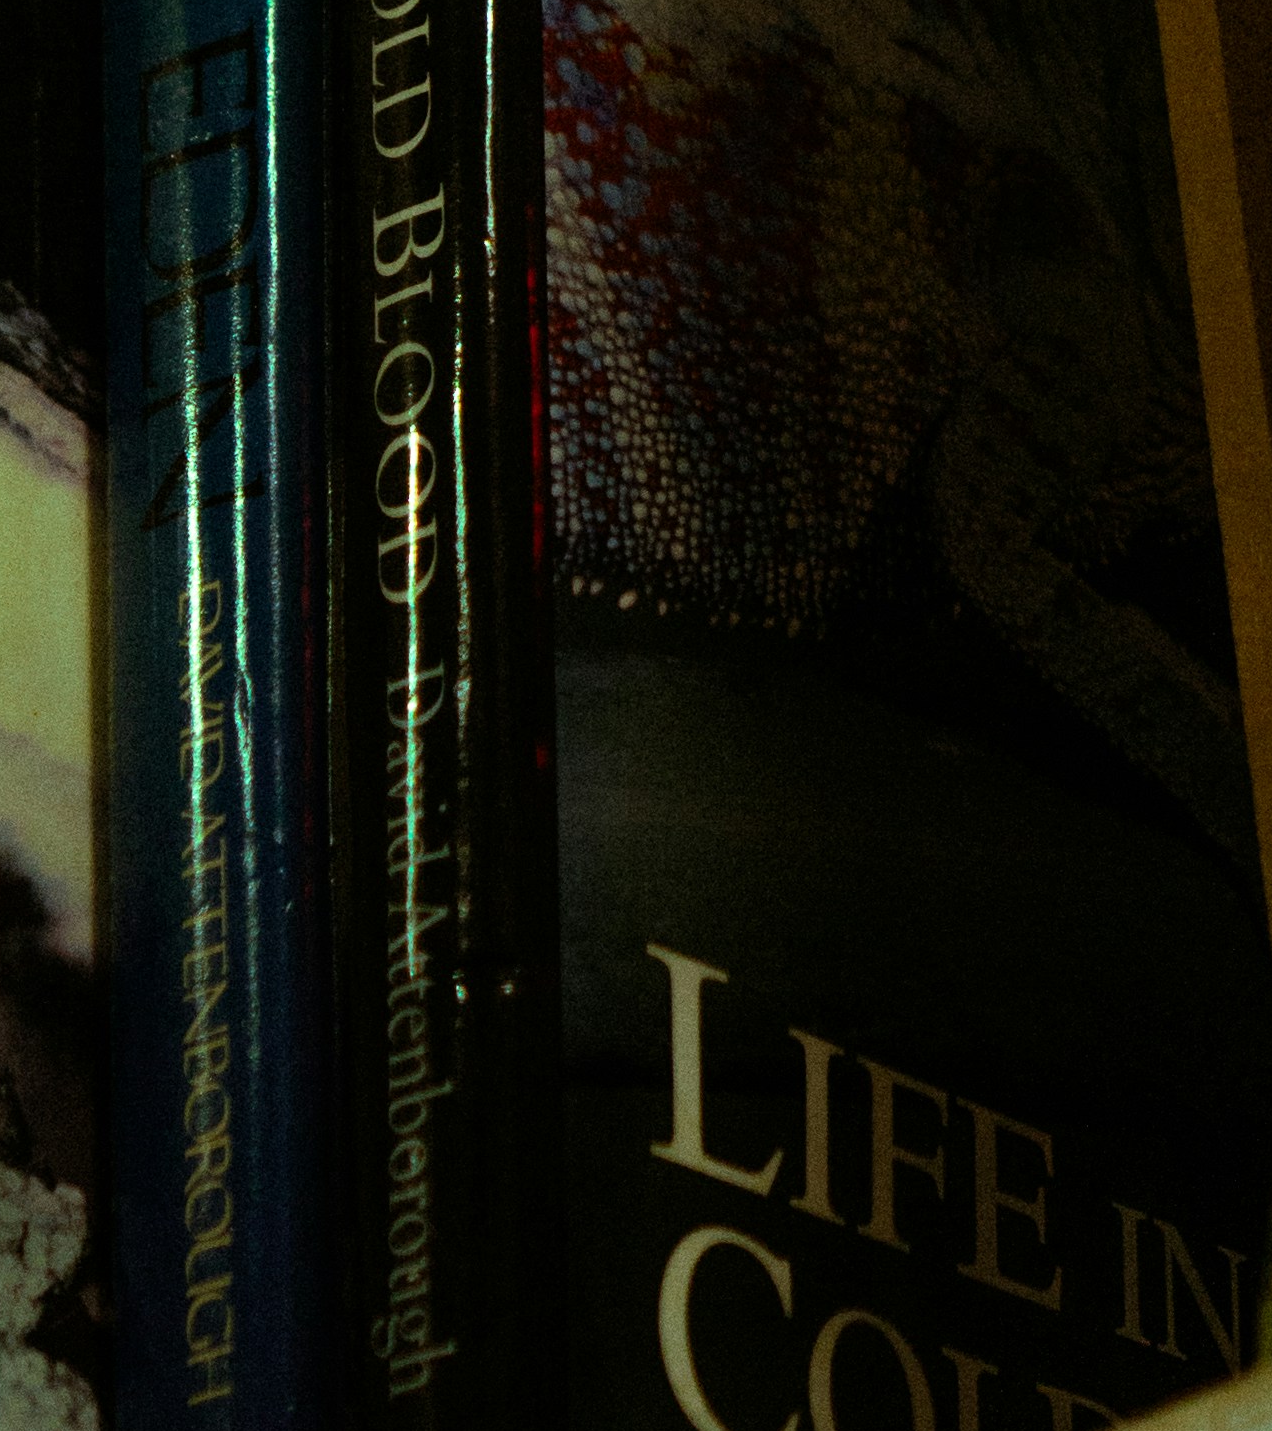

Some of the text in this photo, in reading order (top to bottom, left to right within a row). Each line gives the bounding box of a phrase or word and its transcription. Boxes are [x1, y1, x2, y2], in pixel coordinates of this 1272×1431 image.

[137, 30, 265, 536] EDEN
[175, 578, 235, 1408] DAVID ATTENBOROUGH
[371, 662, 457, 1400] David Attenborough
